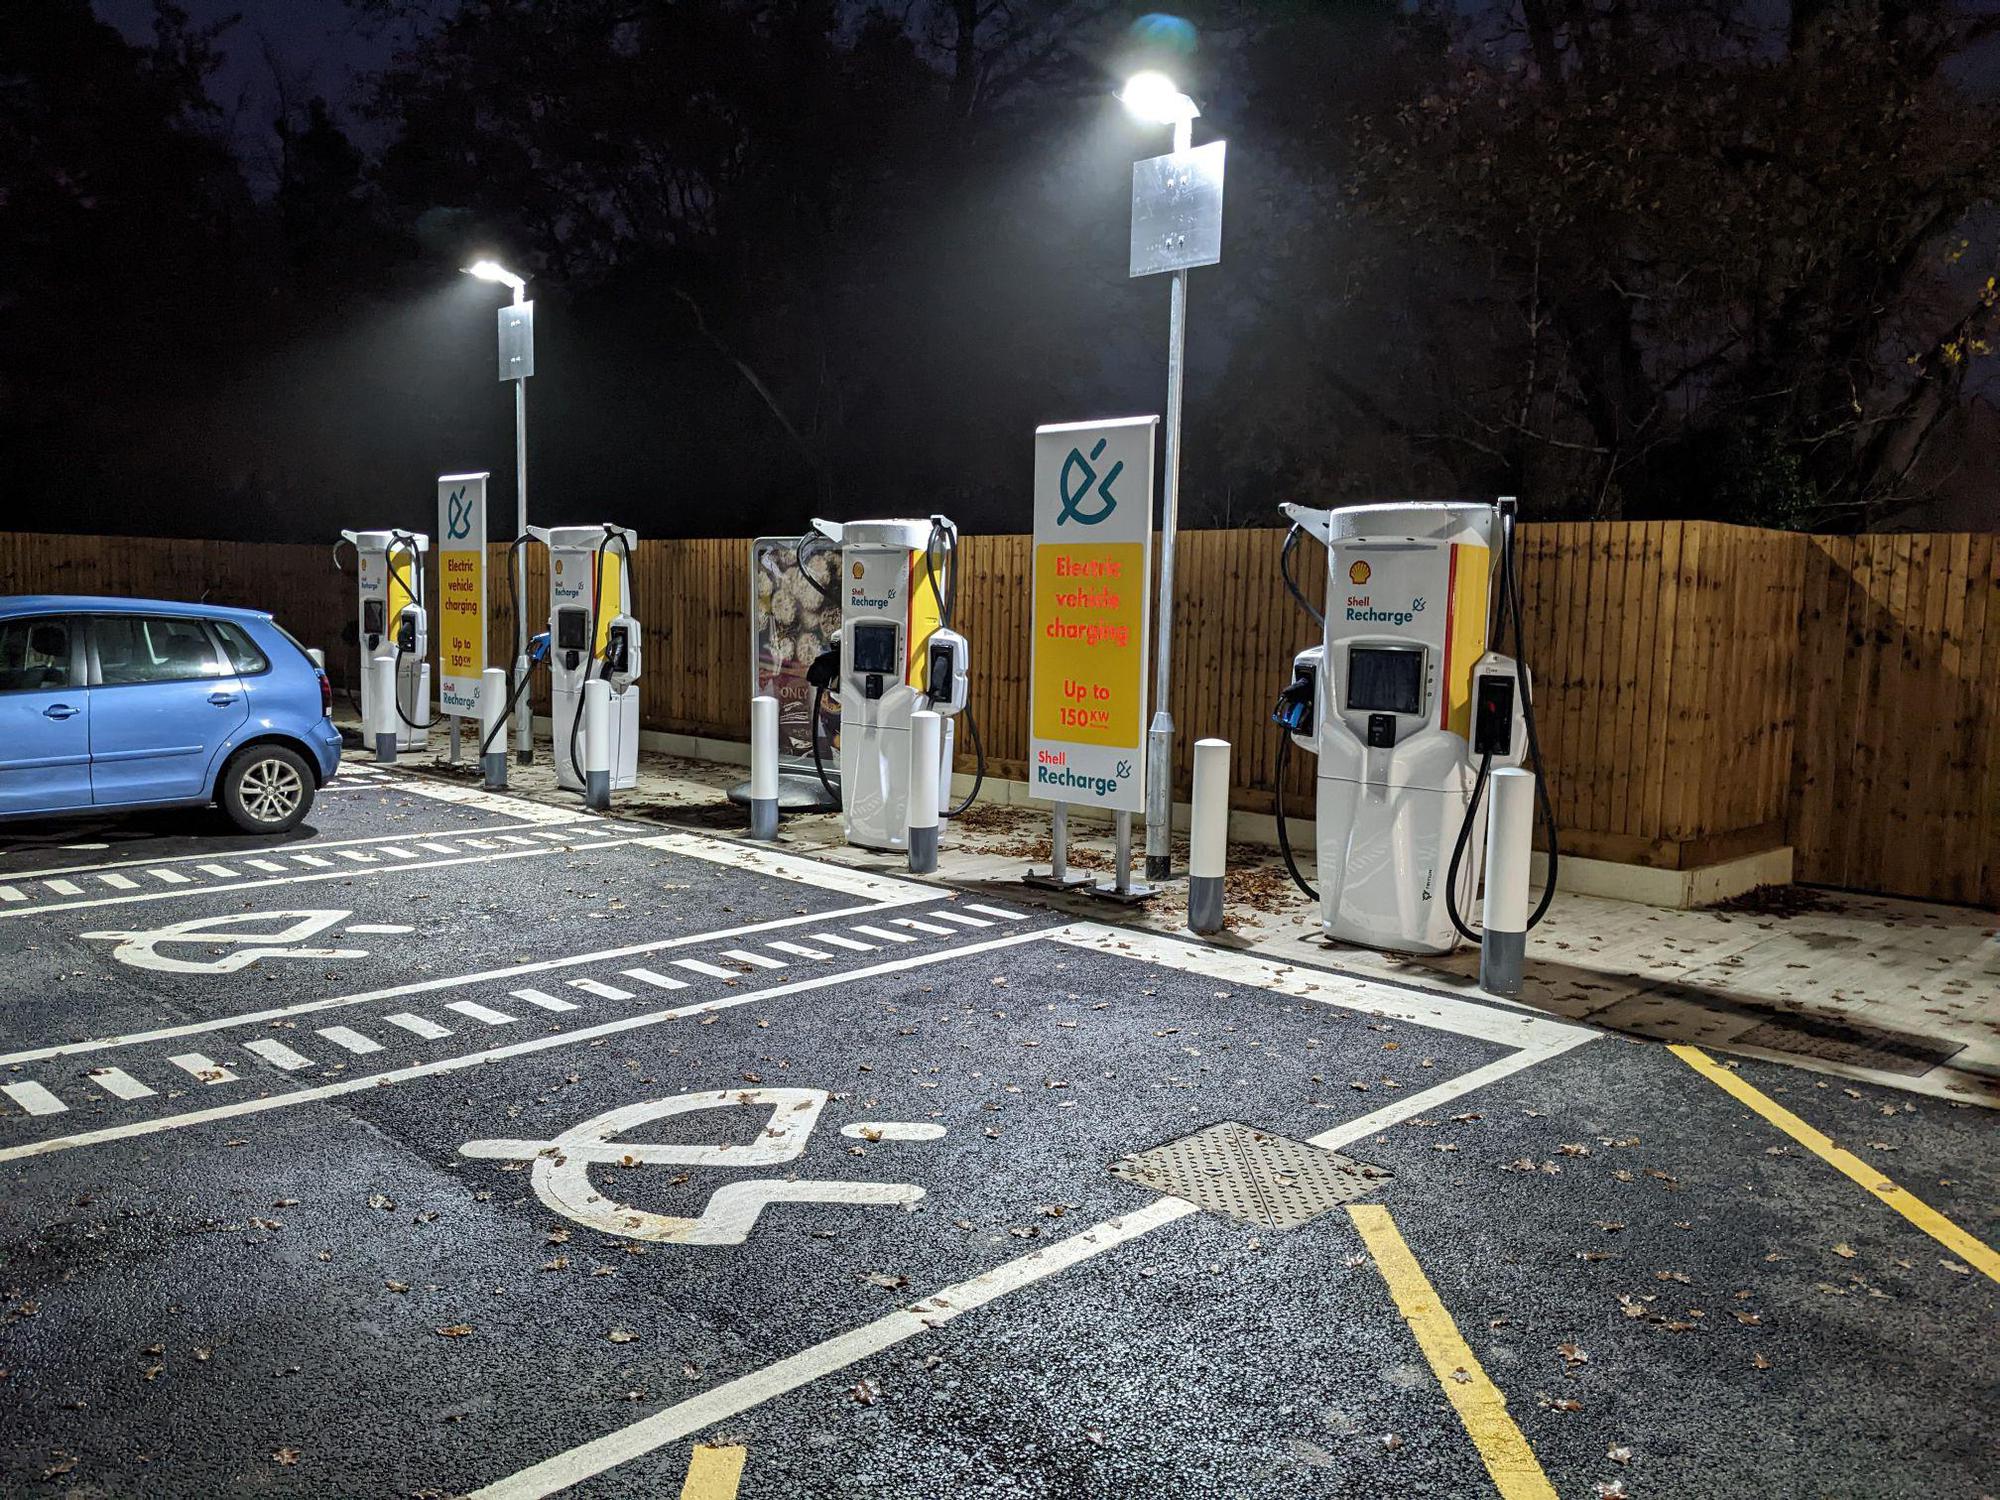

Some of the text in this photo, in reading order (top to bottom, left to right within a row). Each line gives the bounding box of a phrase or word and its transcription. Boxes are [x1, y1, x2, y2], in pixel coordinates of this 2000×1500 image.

[448, 558, 473, 571] Electric
[1056, 554, 1121, 578] Electric
[448, 577, 473, 592] vehicle
[851, 588, 864, 596] Shell
[851, 596, 889, 610] Recharge
[1055, 585, 1120, 608] vehicle
[1347, 596, 1370, 607] Shell
[445, 597, 477, 616] charging
[1346, 607, 1413, 626] Recharge
[1046, 616, 1128, 648] charging
[453, 637, 471, 652] Up to
[780, 686, 809, 699] ONLY
[1064, 679, 1110, 704] Up to
[443, 692, 475, 711] Recharge
[1038, 750, 1066, 766] Shell
[1038, 765, 1117, 797] Recharge
